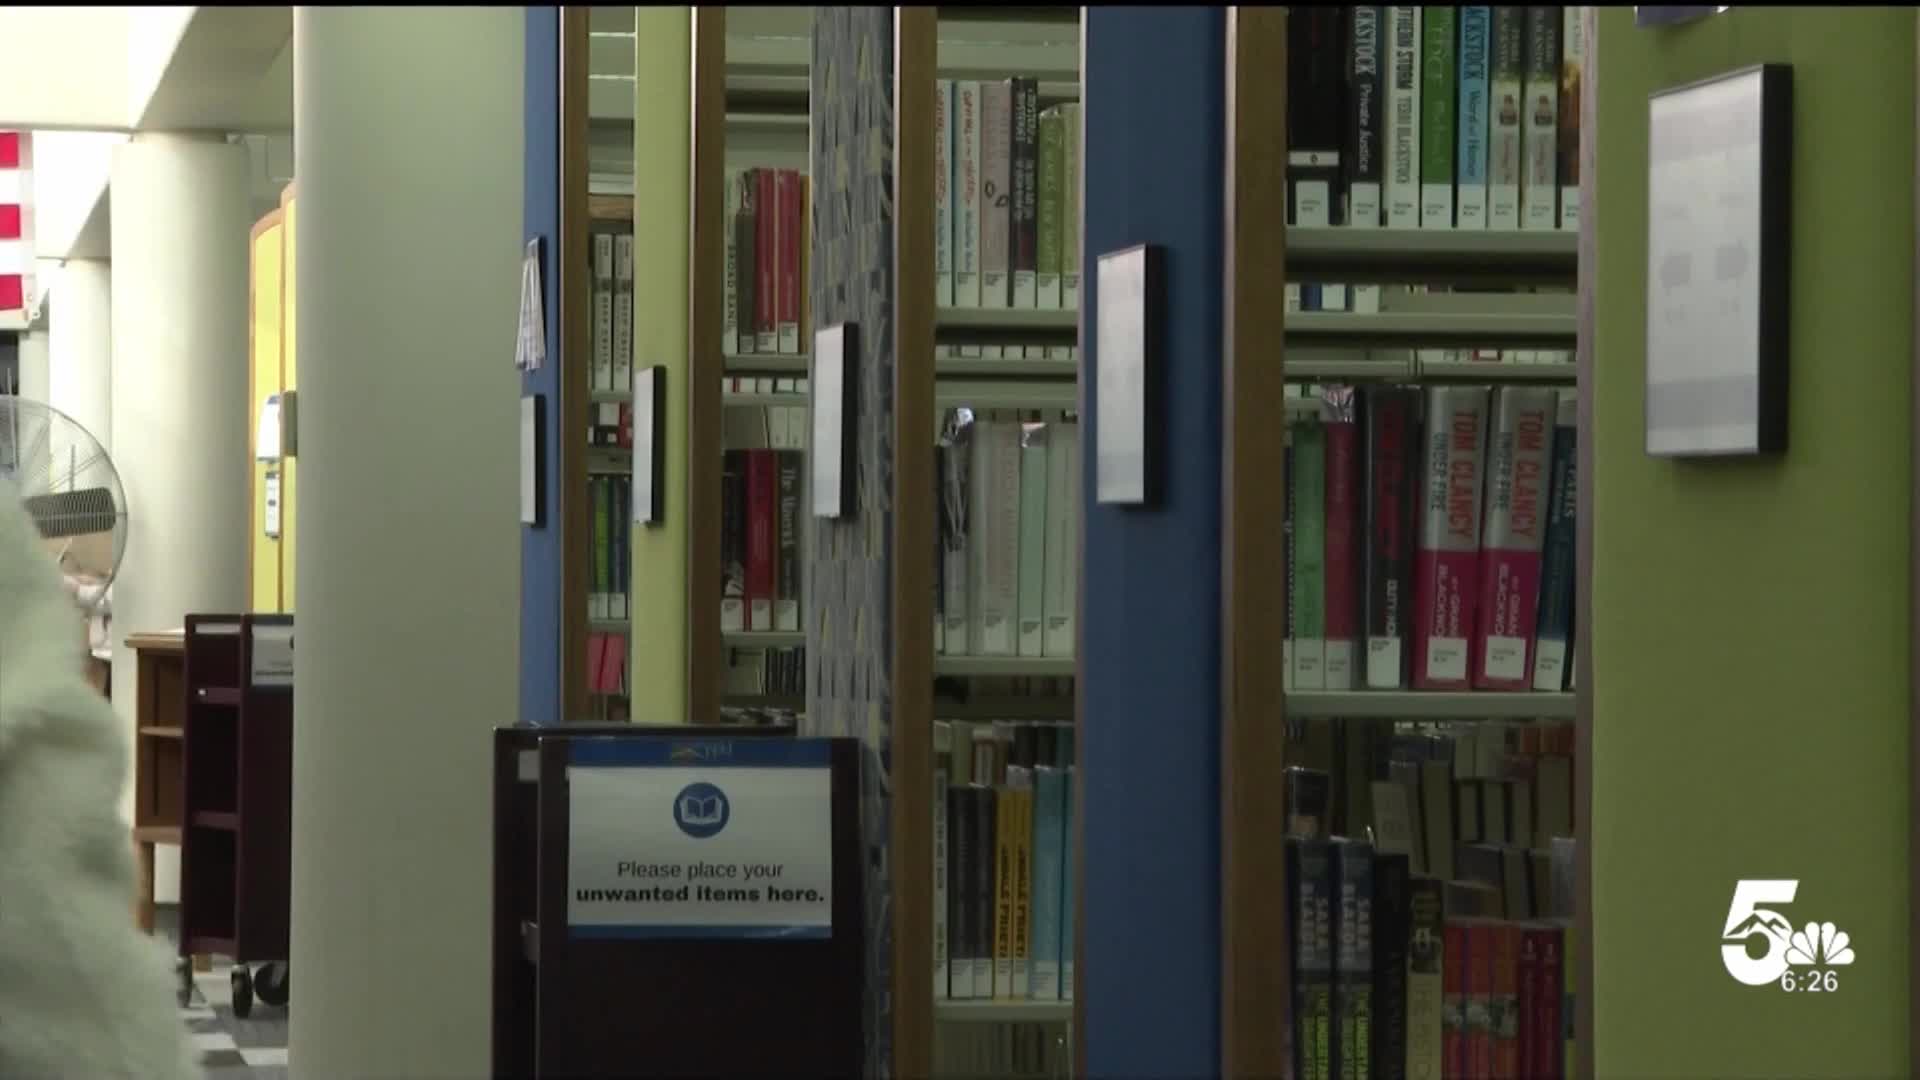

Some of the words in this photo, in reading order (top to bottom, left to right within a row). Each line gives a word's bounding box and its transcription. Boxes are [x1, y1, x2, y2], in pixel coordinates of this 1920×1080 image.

[1396, 50, 1415, 90] STORM
[1359, 83, 1372, 127] Private
[1359, 128, 1373, 173] Justice
[1451, 409, 1481, 452] TOM
[1517, 408, 1545, 451] TOM
[1432, 431, 1449, 479] UNDER
[1430, 480, 1446, 512] FIRE
[1448, 460, 1474, 540] CLANCY
[1511, 460, 1544, 540] CLANCY
[617, 861, 681, 878] Please
[687, 861, 737, 882] place
[743, 865, 783, 882] your
[576, 886, 689, 903] unwanted
[696, 886, 760, 903] items
[767, 886, 825, 903] here.
